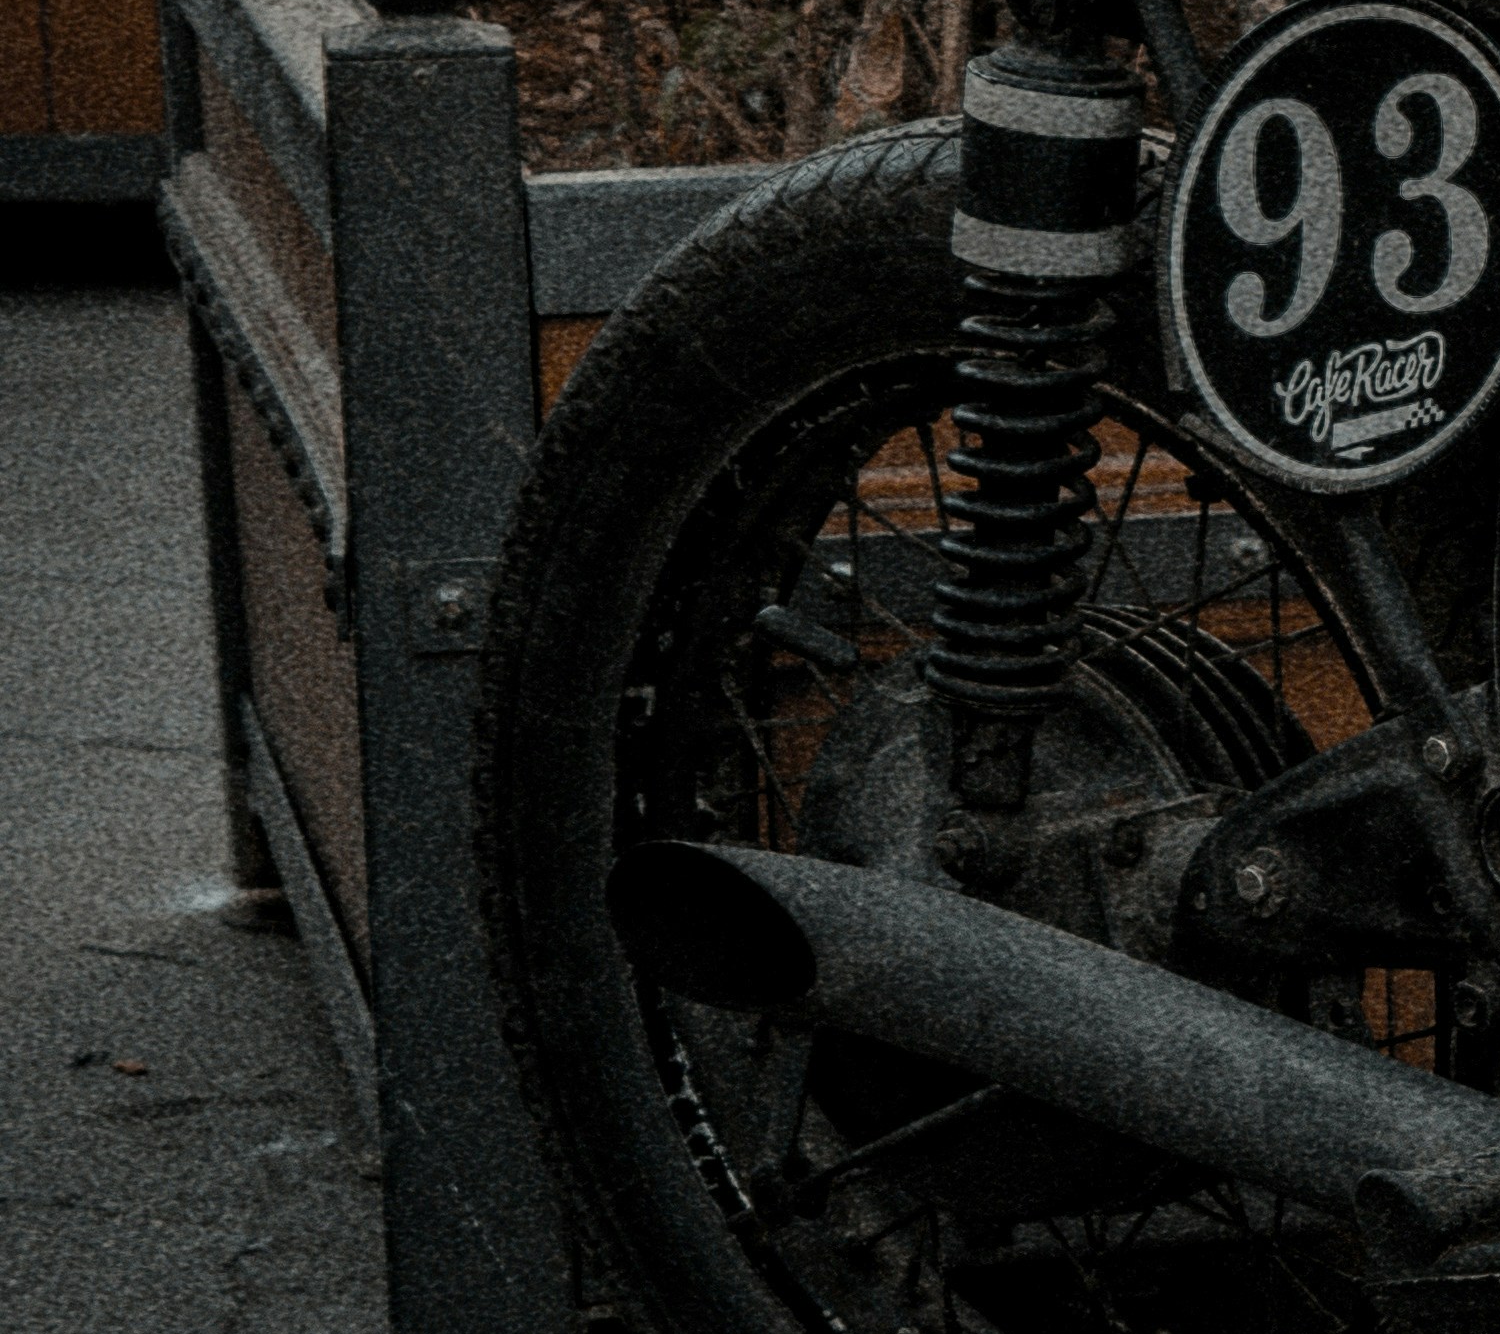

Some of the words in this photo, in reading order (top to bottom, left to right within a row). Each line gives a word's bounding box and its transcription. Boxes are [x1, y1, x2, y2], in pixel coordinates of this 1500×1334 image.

[1216, 73, 1491, 338] 93
[1274, 350, 1352, 443] Cafe
[1347, 331, 1446, 407] Racer
